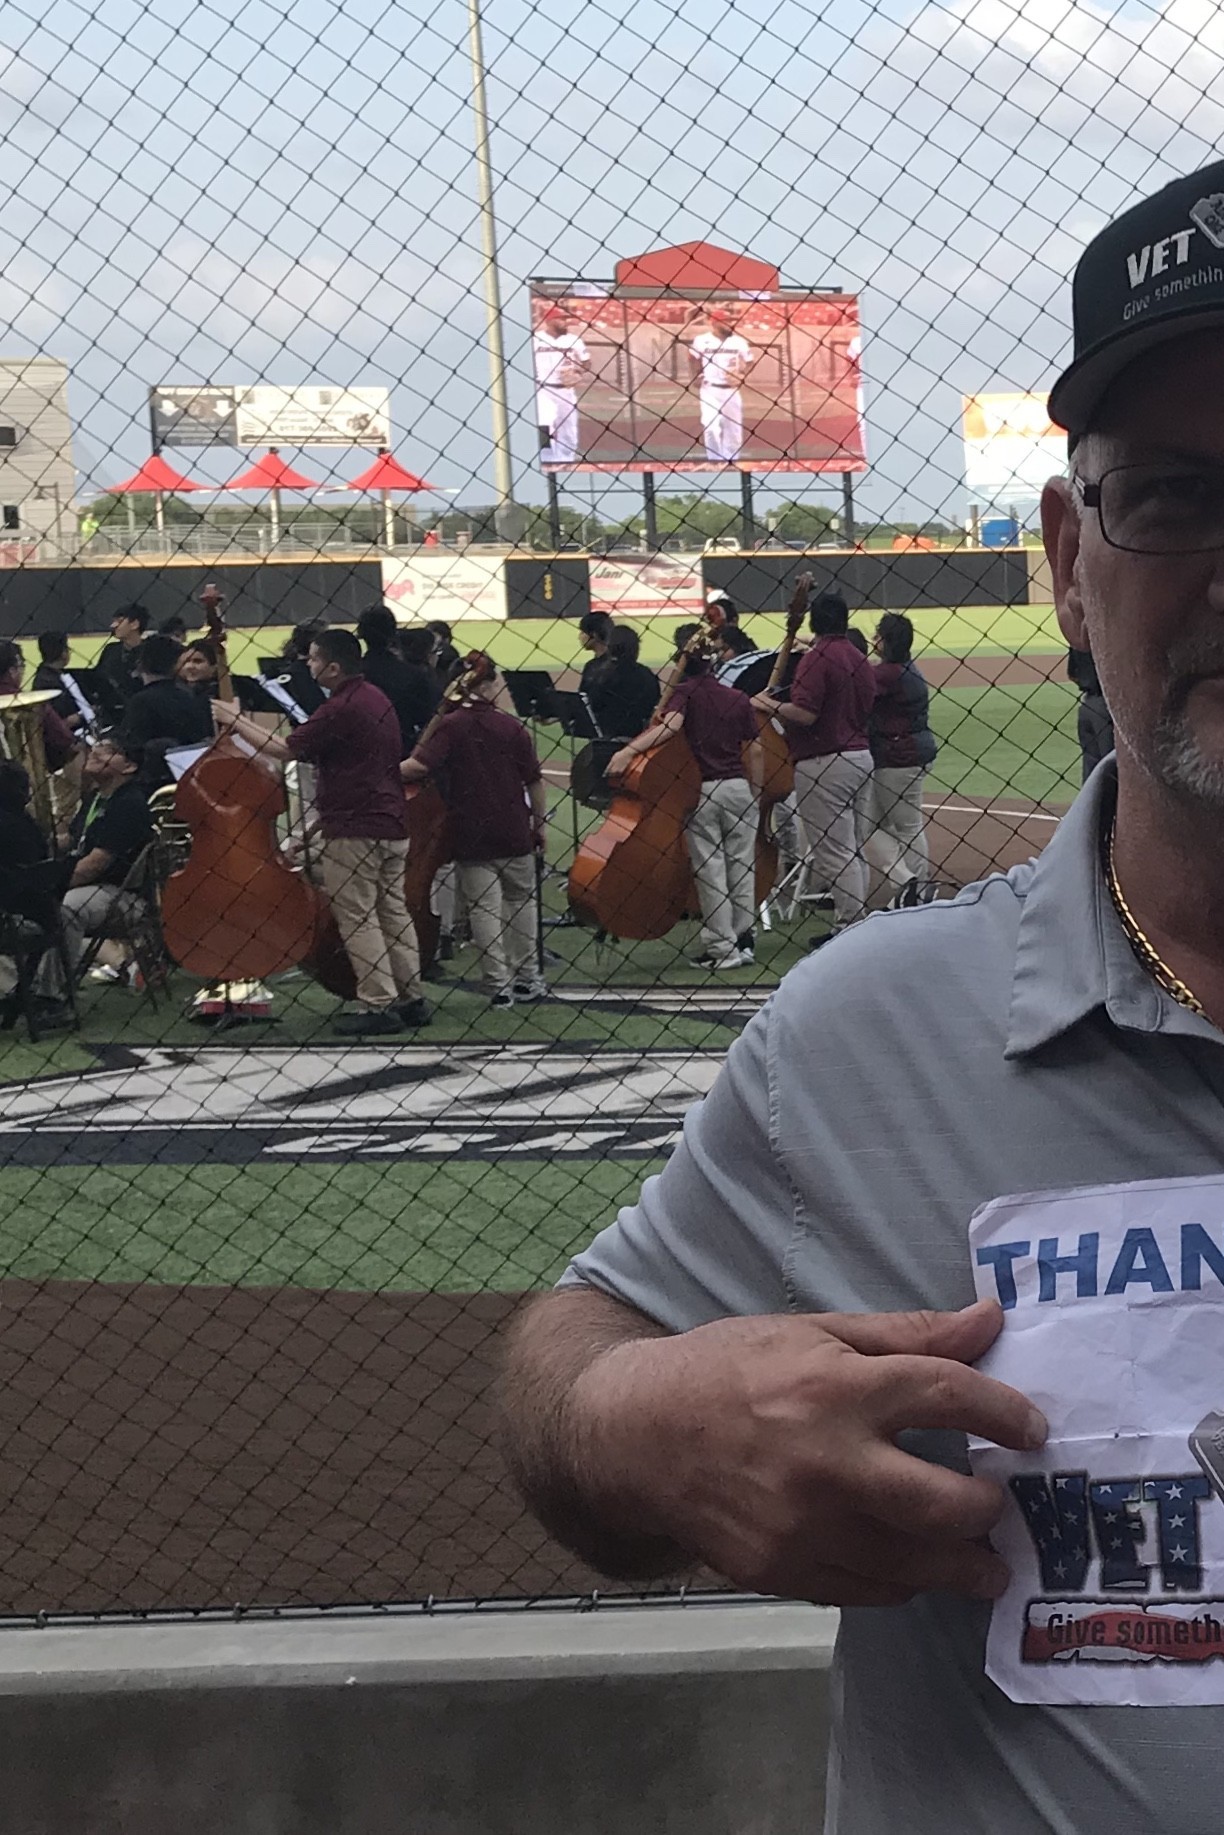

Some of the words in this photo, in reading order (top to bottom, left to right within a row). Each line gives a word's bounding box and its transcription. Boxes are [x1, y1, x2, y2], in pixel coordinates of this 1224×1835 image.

[1127, 228, 1196, 288] VET
[1123, 295, 1150, 320] Give
[1009, 1468, 1211, 1593] VET
[1046, 1613, 1106, 1645] Give
